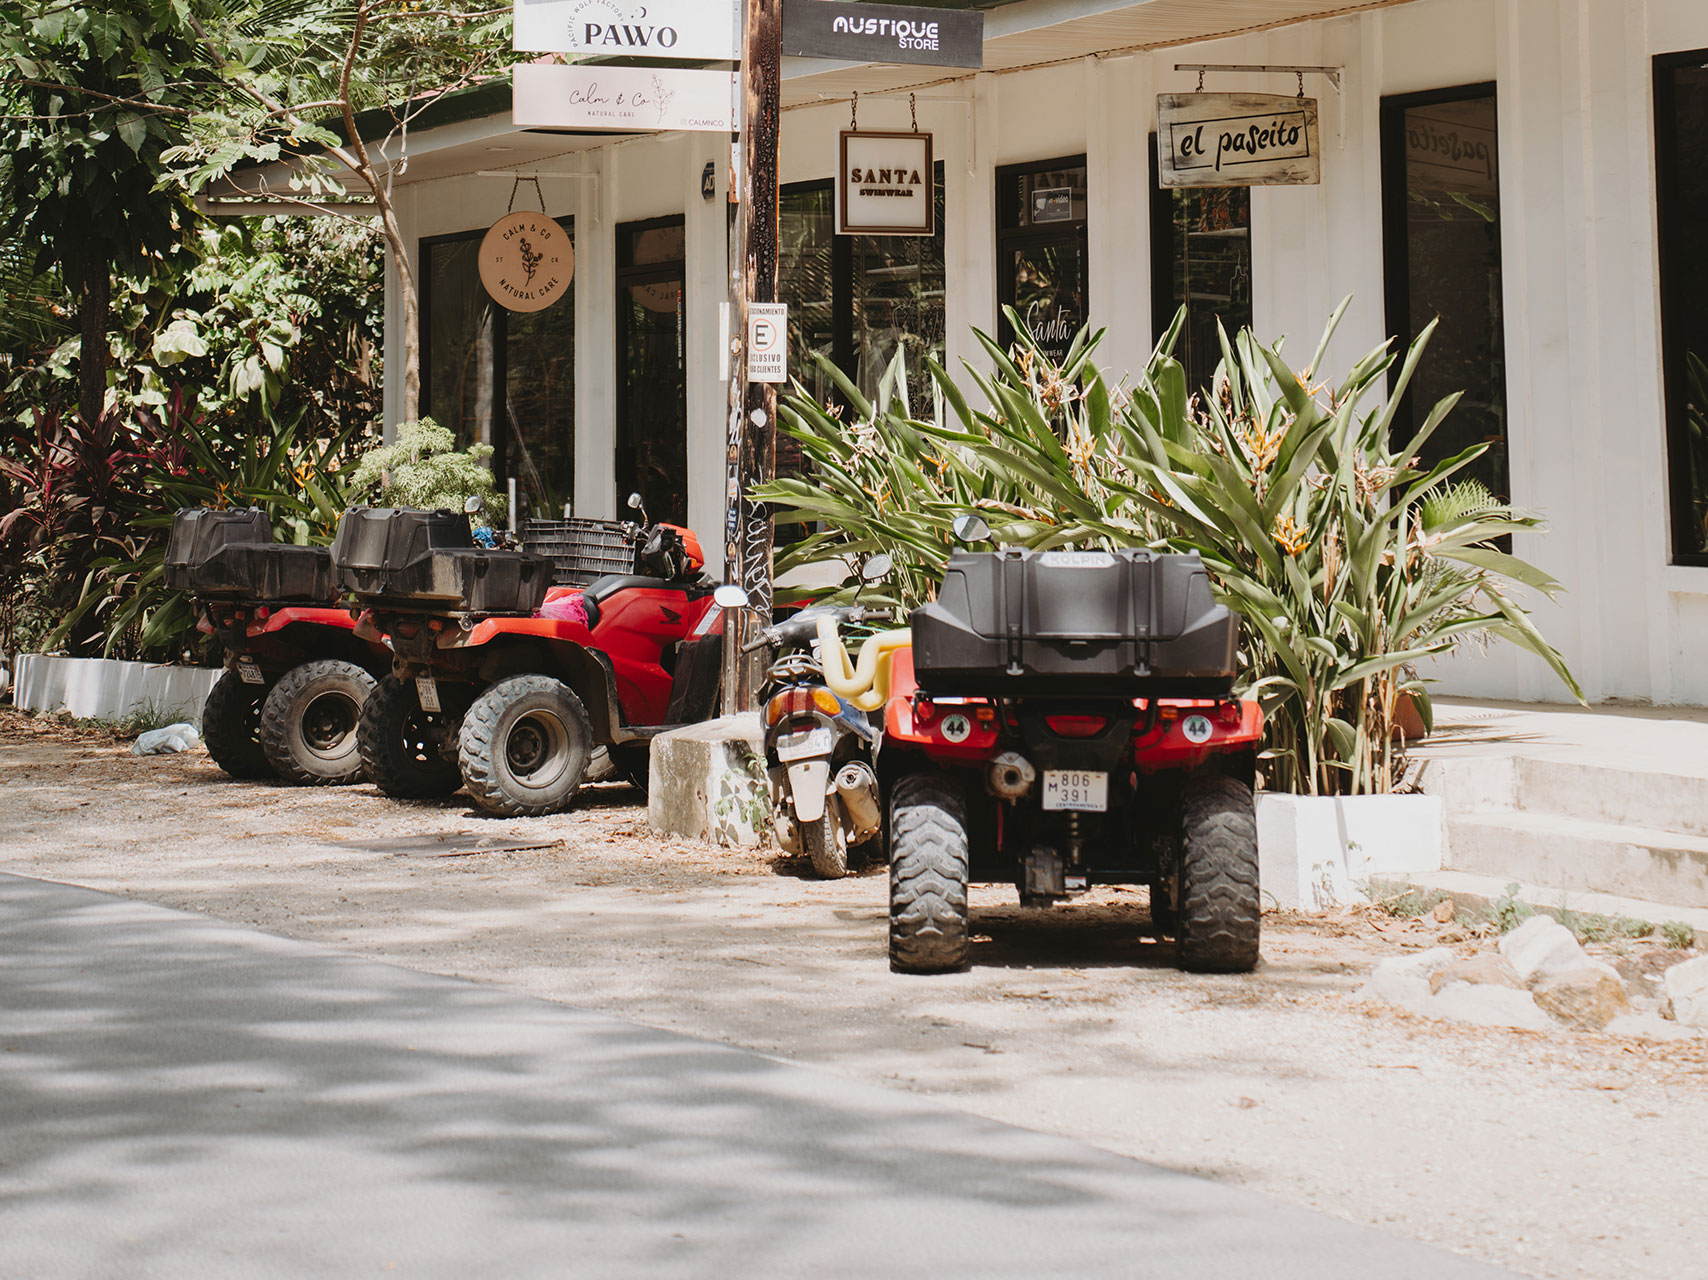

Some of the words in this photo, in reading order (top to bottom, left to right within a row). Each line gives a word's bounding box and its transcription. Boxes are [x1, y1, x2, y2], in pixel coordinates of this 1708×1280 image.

[567, 15, 579, 48] PACIFIC
[597, 0, 624, 22] FACTORY
[584, 22, 678, 48] PAWO
[898, 38, 939, 51] STORE
[569, 82, 609, 105] Calm
[632, 92, 650, 107] Co
[587, 110, 616, 118] NATURAL
[688, 119, 724, 127] CALMNCO
[1180, 125, 1205, 157] el
[851, 168, 921, 185] SANTA
[859, 188, 913, 197] SWIMWEAR
[502, 224, 525, 240] CALM
[530, 224, 536, 232] &
[540, 228, 551, 240] CO
[498, 278, 535, 300] NATURAL
[538, 277, 559, 296] CARE
[1027, 300, 1072, 343] Santa
[755, 324, 769, 345] E
[946, 720, 966, 735] 44
[1188, 721, 1207, 736] 44
[1048, 782, 1058, 792] M
[1061, 773, 1090, 787] 806
[1061, 789, 1088, 802] 391
